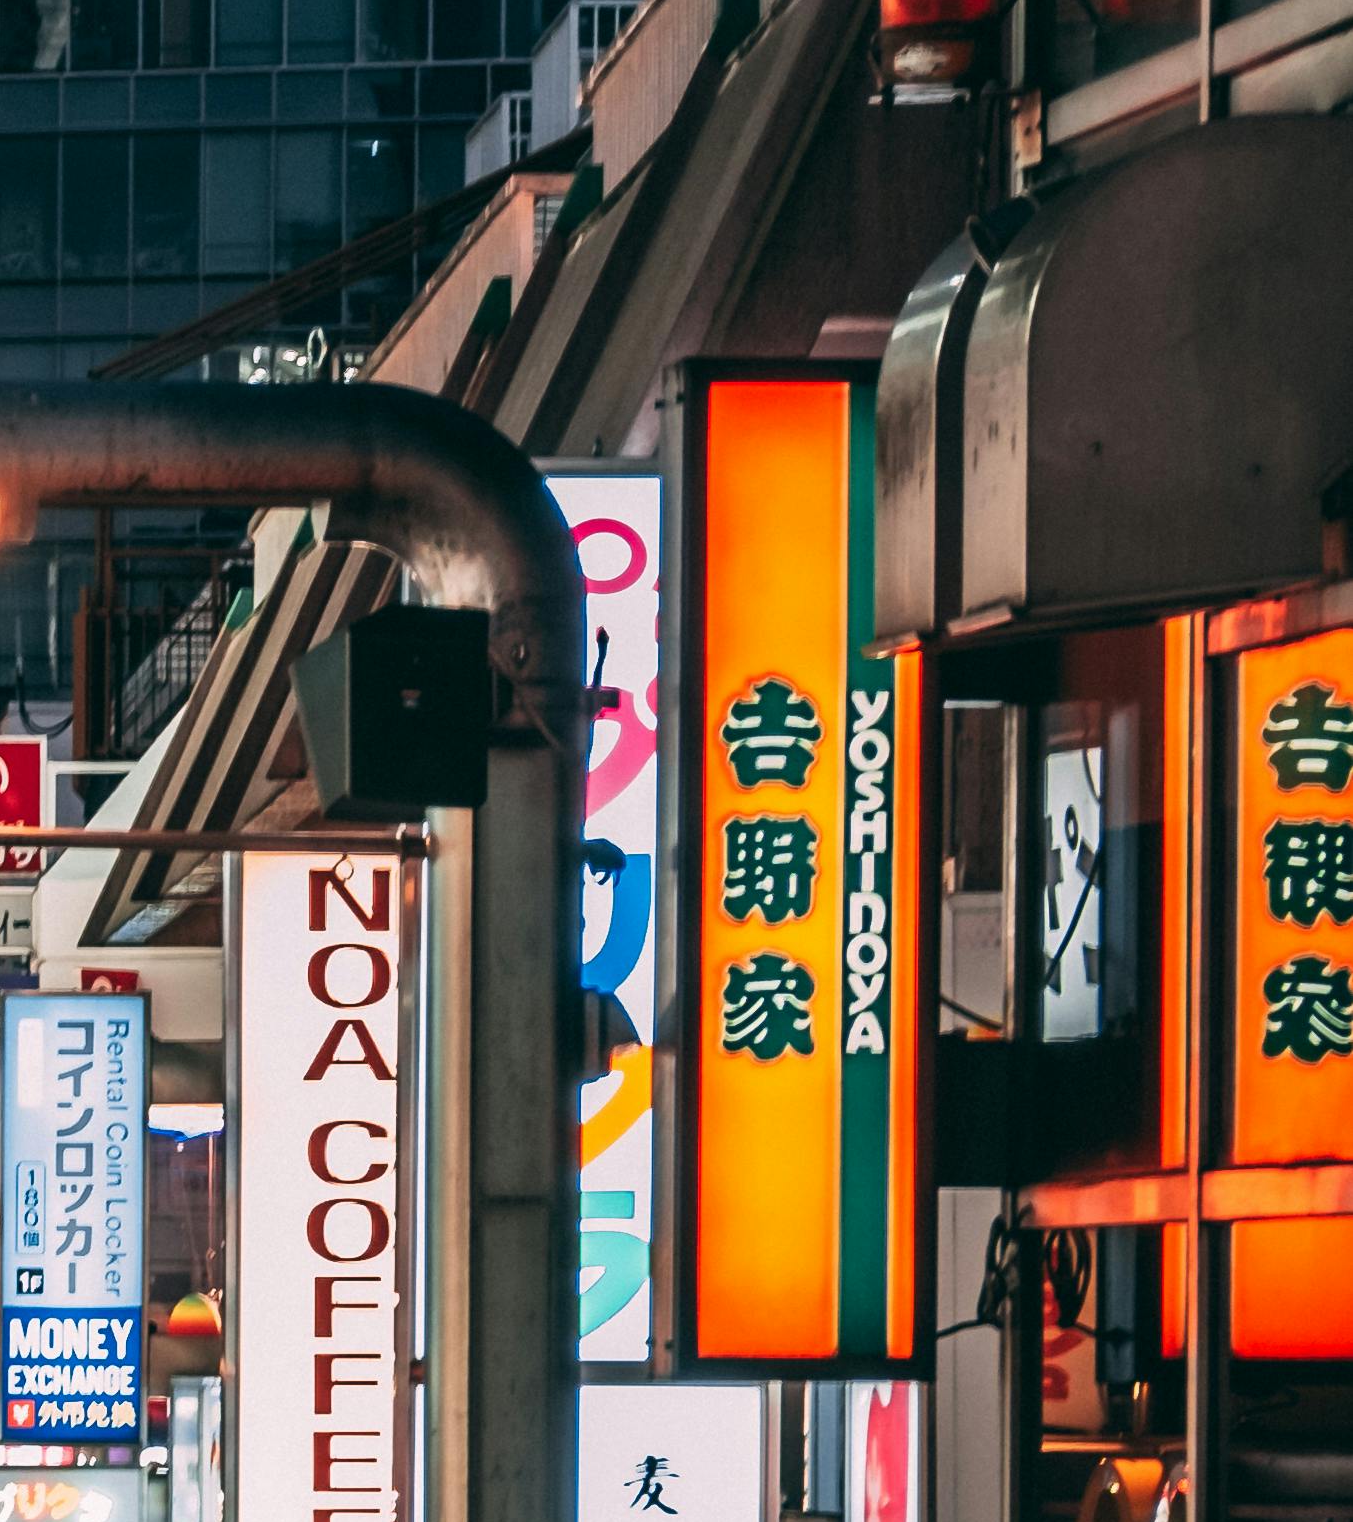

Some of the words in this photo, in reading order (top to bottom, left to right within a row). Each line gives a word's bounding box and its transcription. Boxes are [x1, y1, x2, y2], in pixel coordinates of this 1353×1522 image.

[720, 676, 824, 1064] 吉野家
[846, 688, 891, 1056] YOSHINOYA
[304, 869, 393, 1081] NOA
[106, 1018, 130, 1111] Rental
[55, 1019, 95, 1295] コインロッカー
[106, 1124, 128, 1188] Coin
[104, 1198, 128, 1299] Locker
[7, 1365, 136, 1395] EXCHANGE
[9, 1317, 134, 1359] MONEY
